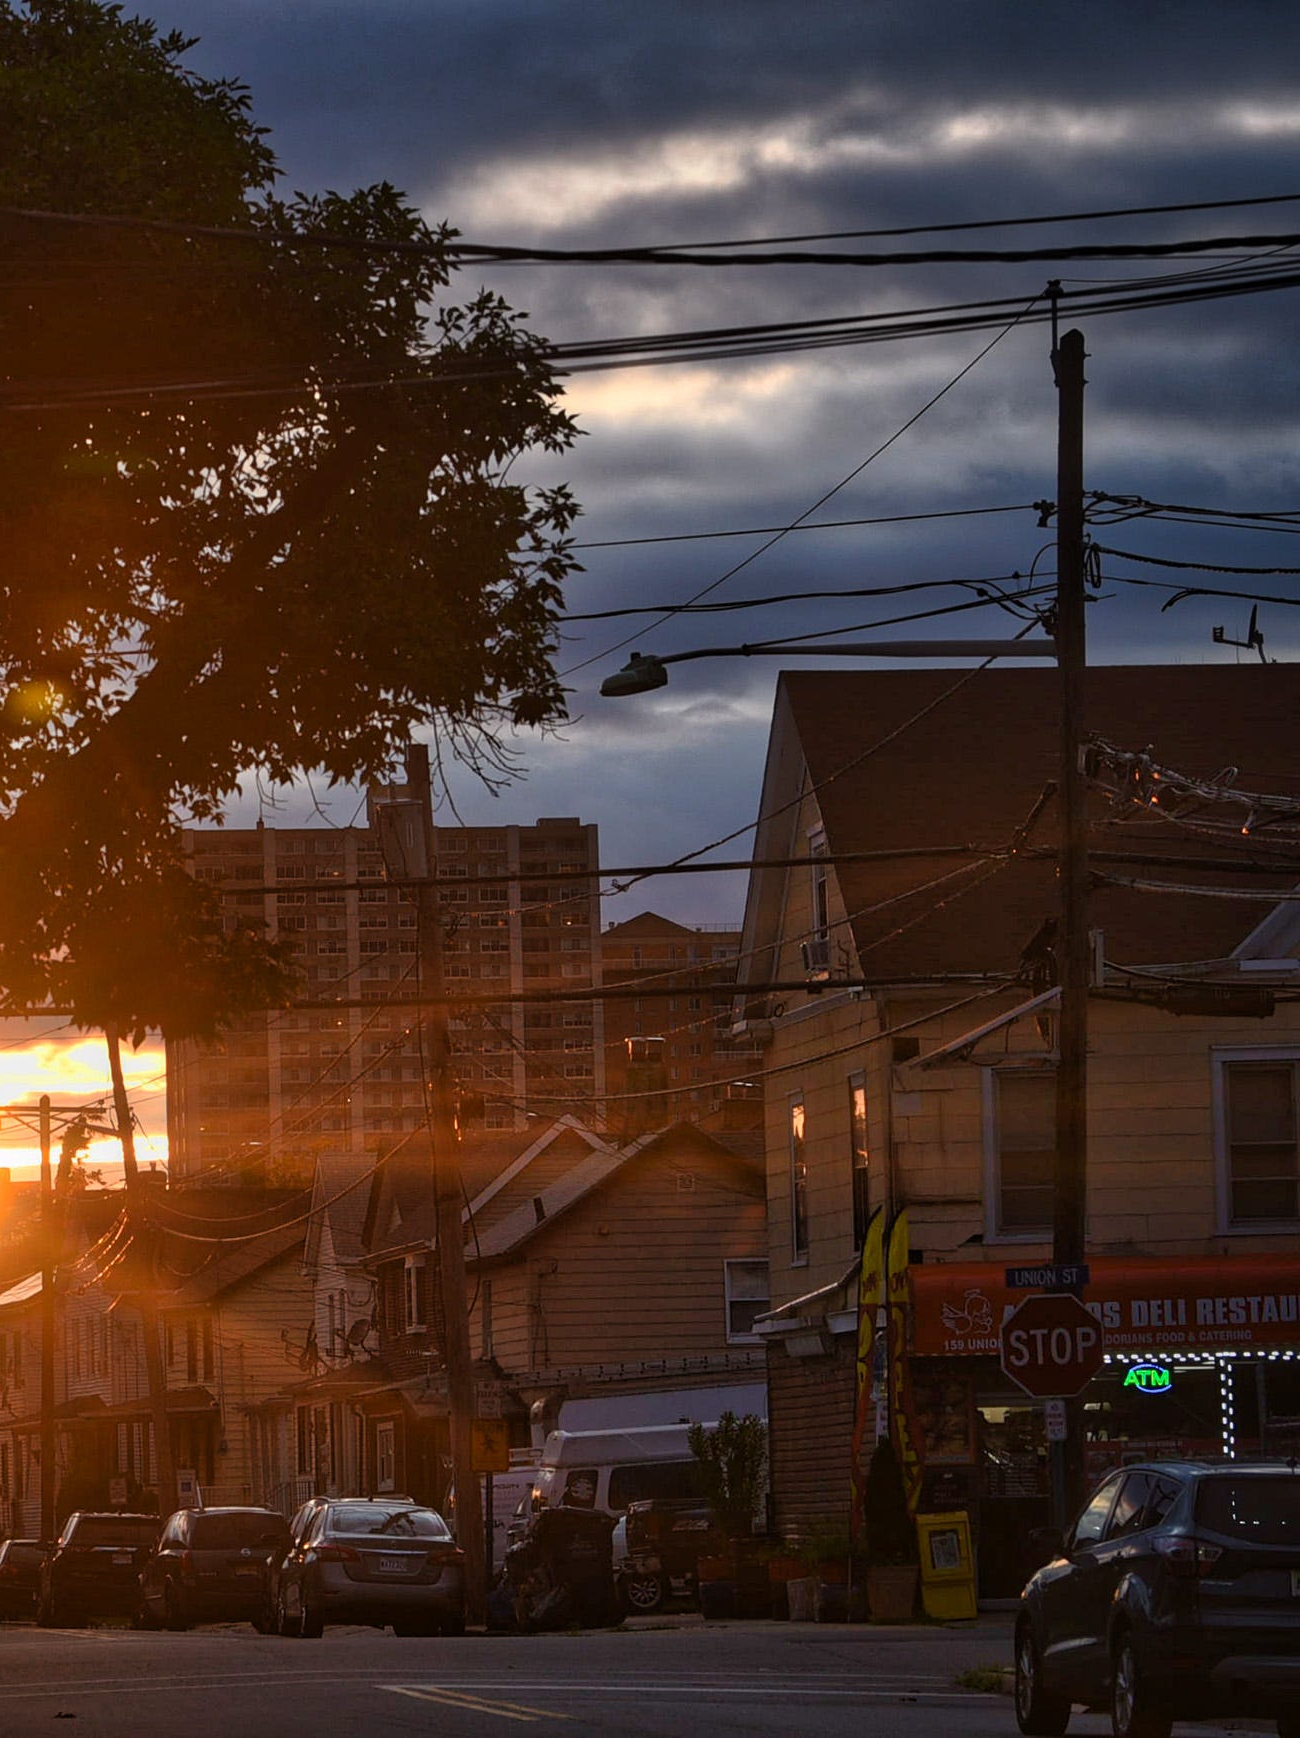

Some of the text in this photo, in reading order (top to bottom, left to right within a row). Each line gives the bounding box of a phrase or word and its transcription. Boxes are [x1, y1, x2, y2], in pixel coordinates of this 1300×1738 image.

[1014, 1268, 1079, 1286] UNION ST
[1130, 1298, 1188, 1328] DELI
[1195, 1295, 1300, 1326] RESTAU
[944, 1339, 965, 1351] 159
[1009, 1325, 1098, 1367] STOP
[1104, 1332, 1153, 1346] DORIANS
[1155, 1331, 1186, 1344] FOOD
[1198, 1329, 1253, 1342] CATERING
[1123, 1368, 1171, 1387] ATM
